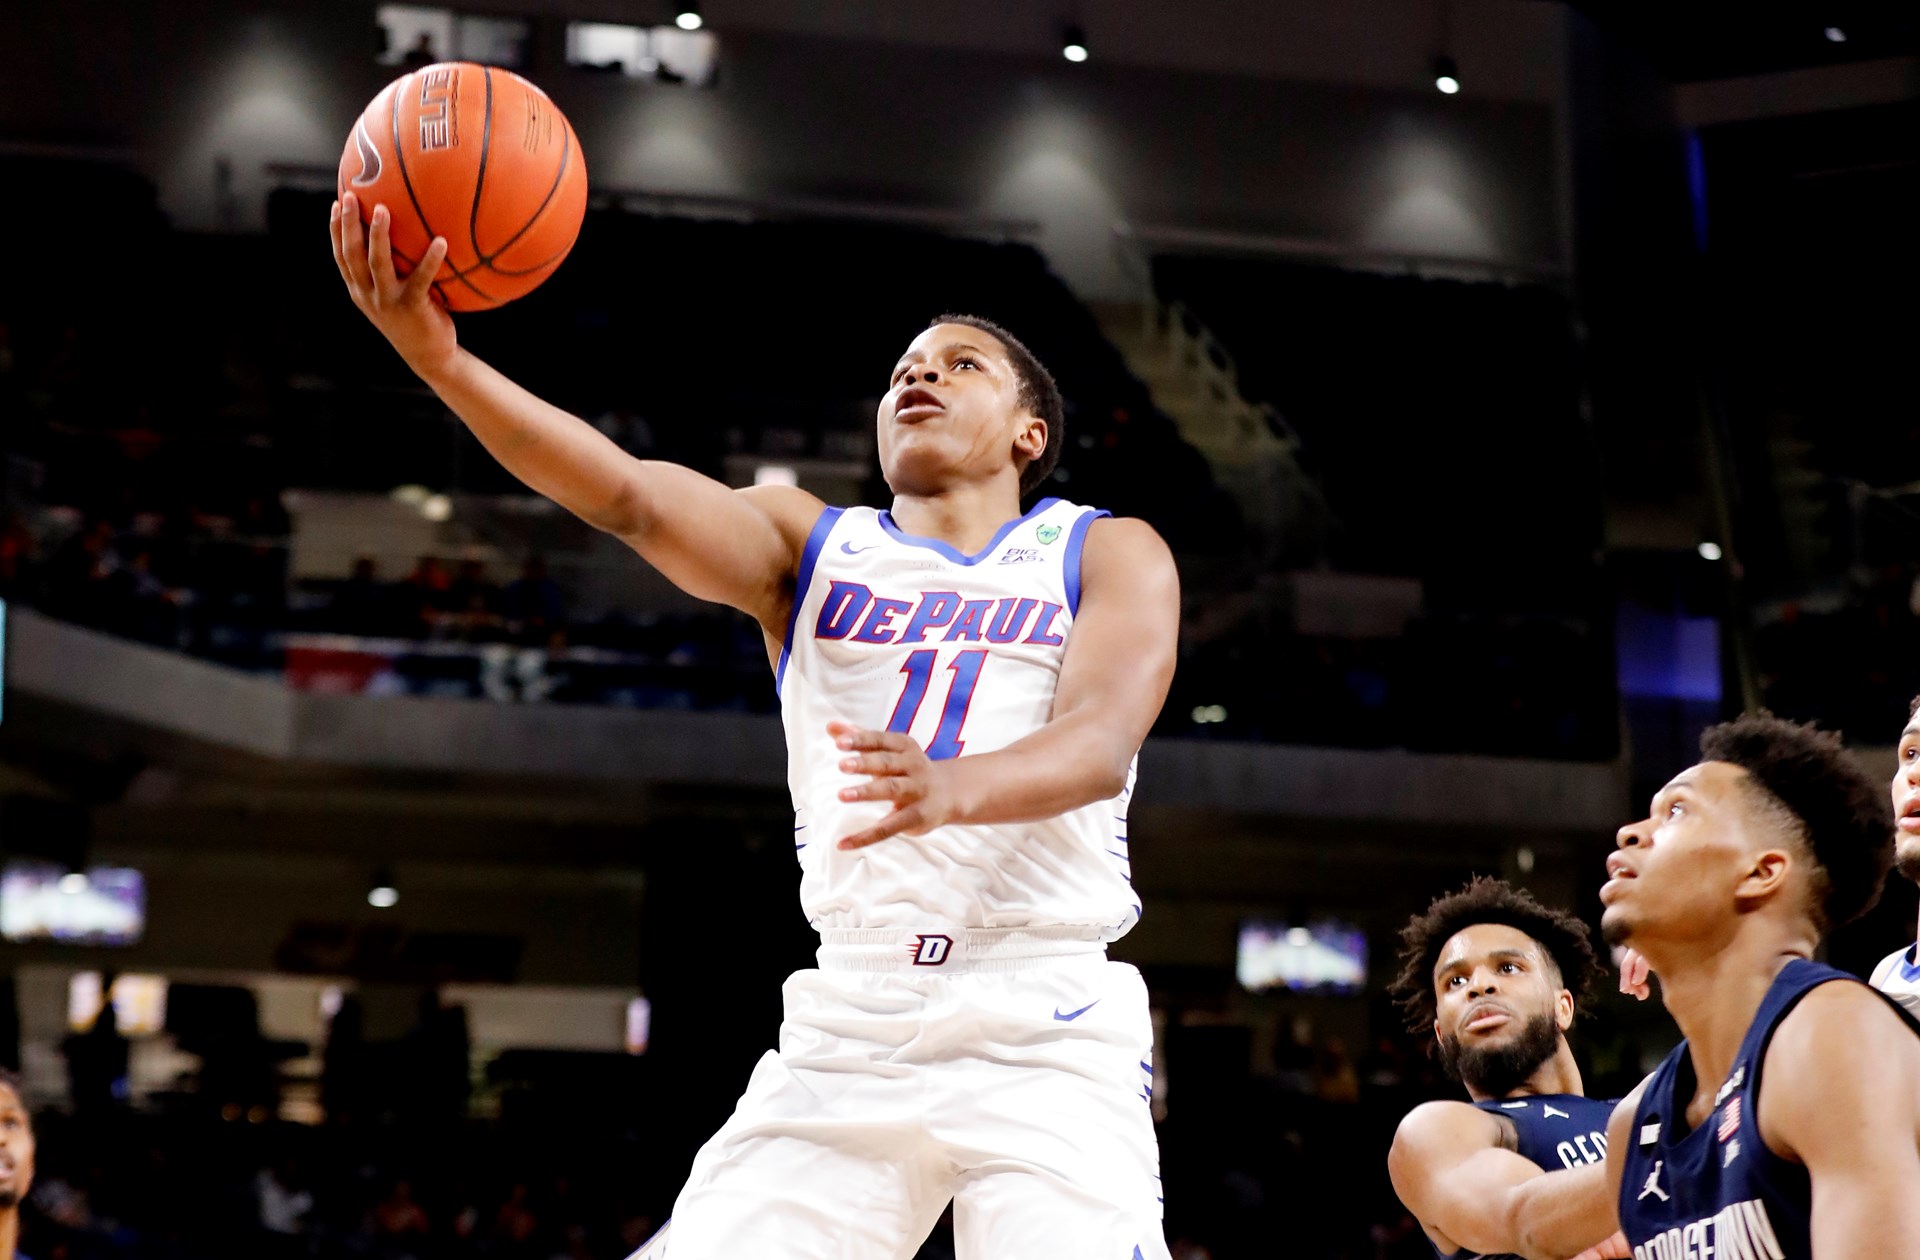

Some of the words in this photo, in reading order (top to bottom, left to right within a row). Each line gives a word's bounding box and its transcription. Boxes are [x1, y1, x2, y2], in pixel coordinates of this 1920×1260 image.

[419, 69, 450, 152] ELITE
[1006, 548, 1039, 556] BIG
[886, 649, 989, 761] 11
